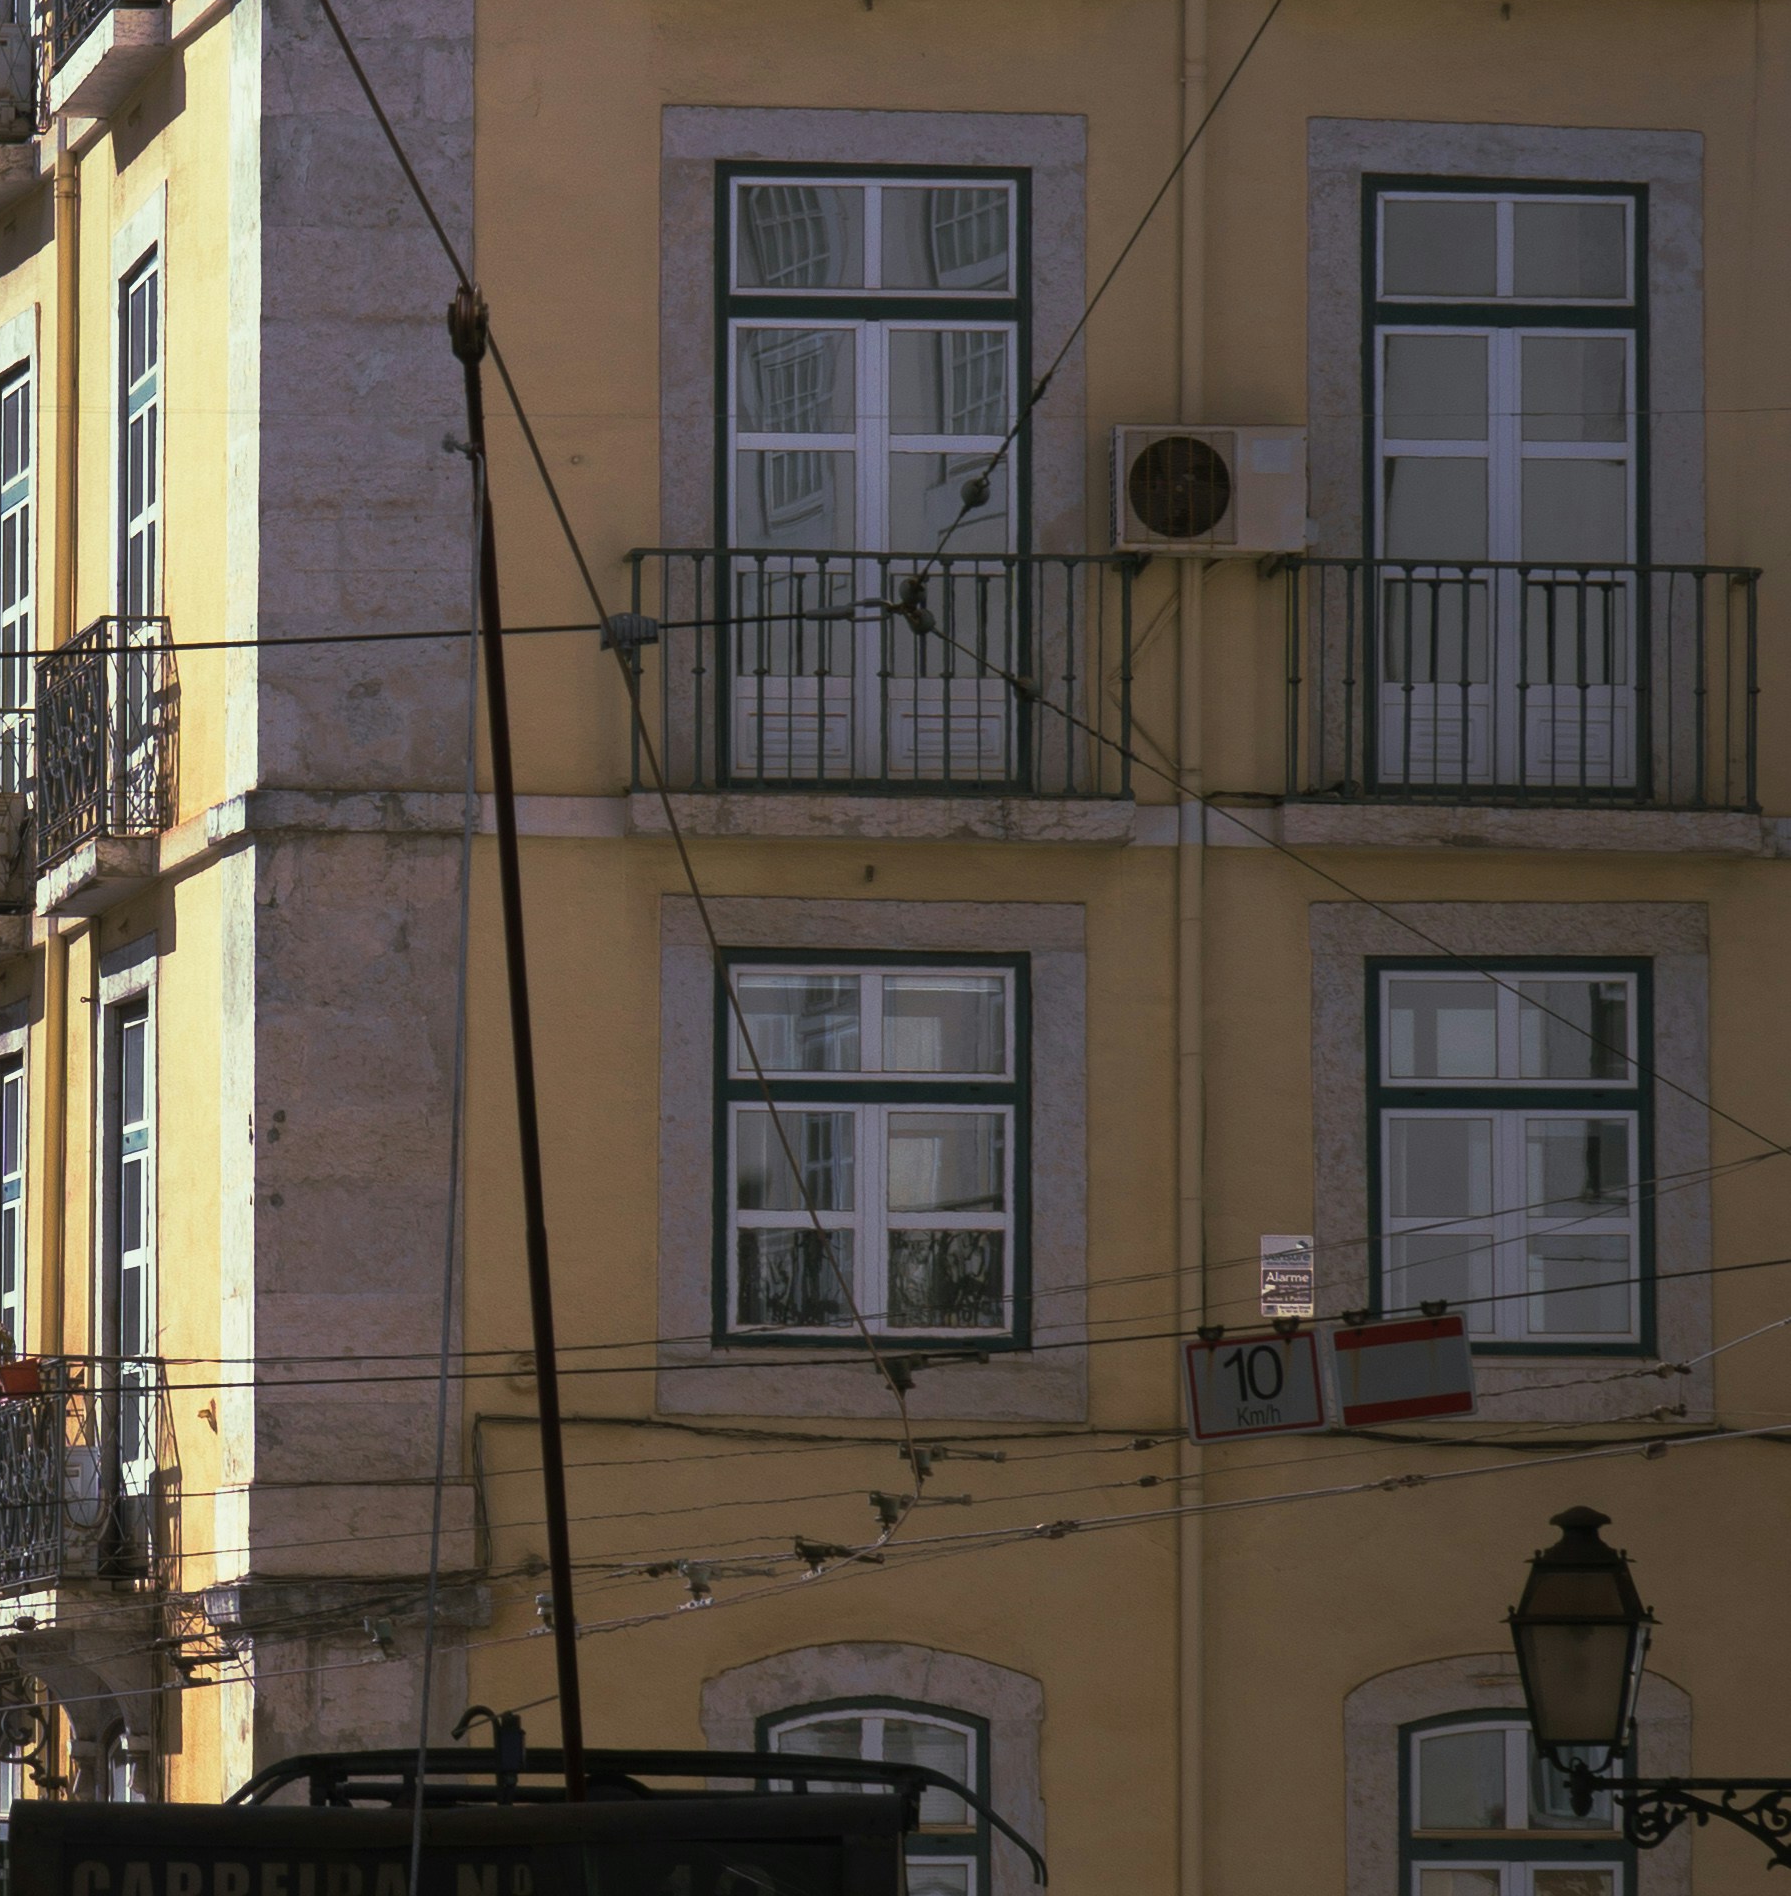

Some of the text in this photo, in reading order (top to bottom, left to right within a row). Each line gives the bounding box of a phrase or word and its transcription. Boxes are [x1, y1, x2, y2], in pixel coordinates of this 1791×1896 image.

[1266, 1272, 1310, 1283] Alarme
[1223, 1344, 1284, 1402] 10
[1236, 1404, 1282, 1427] Km/h
